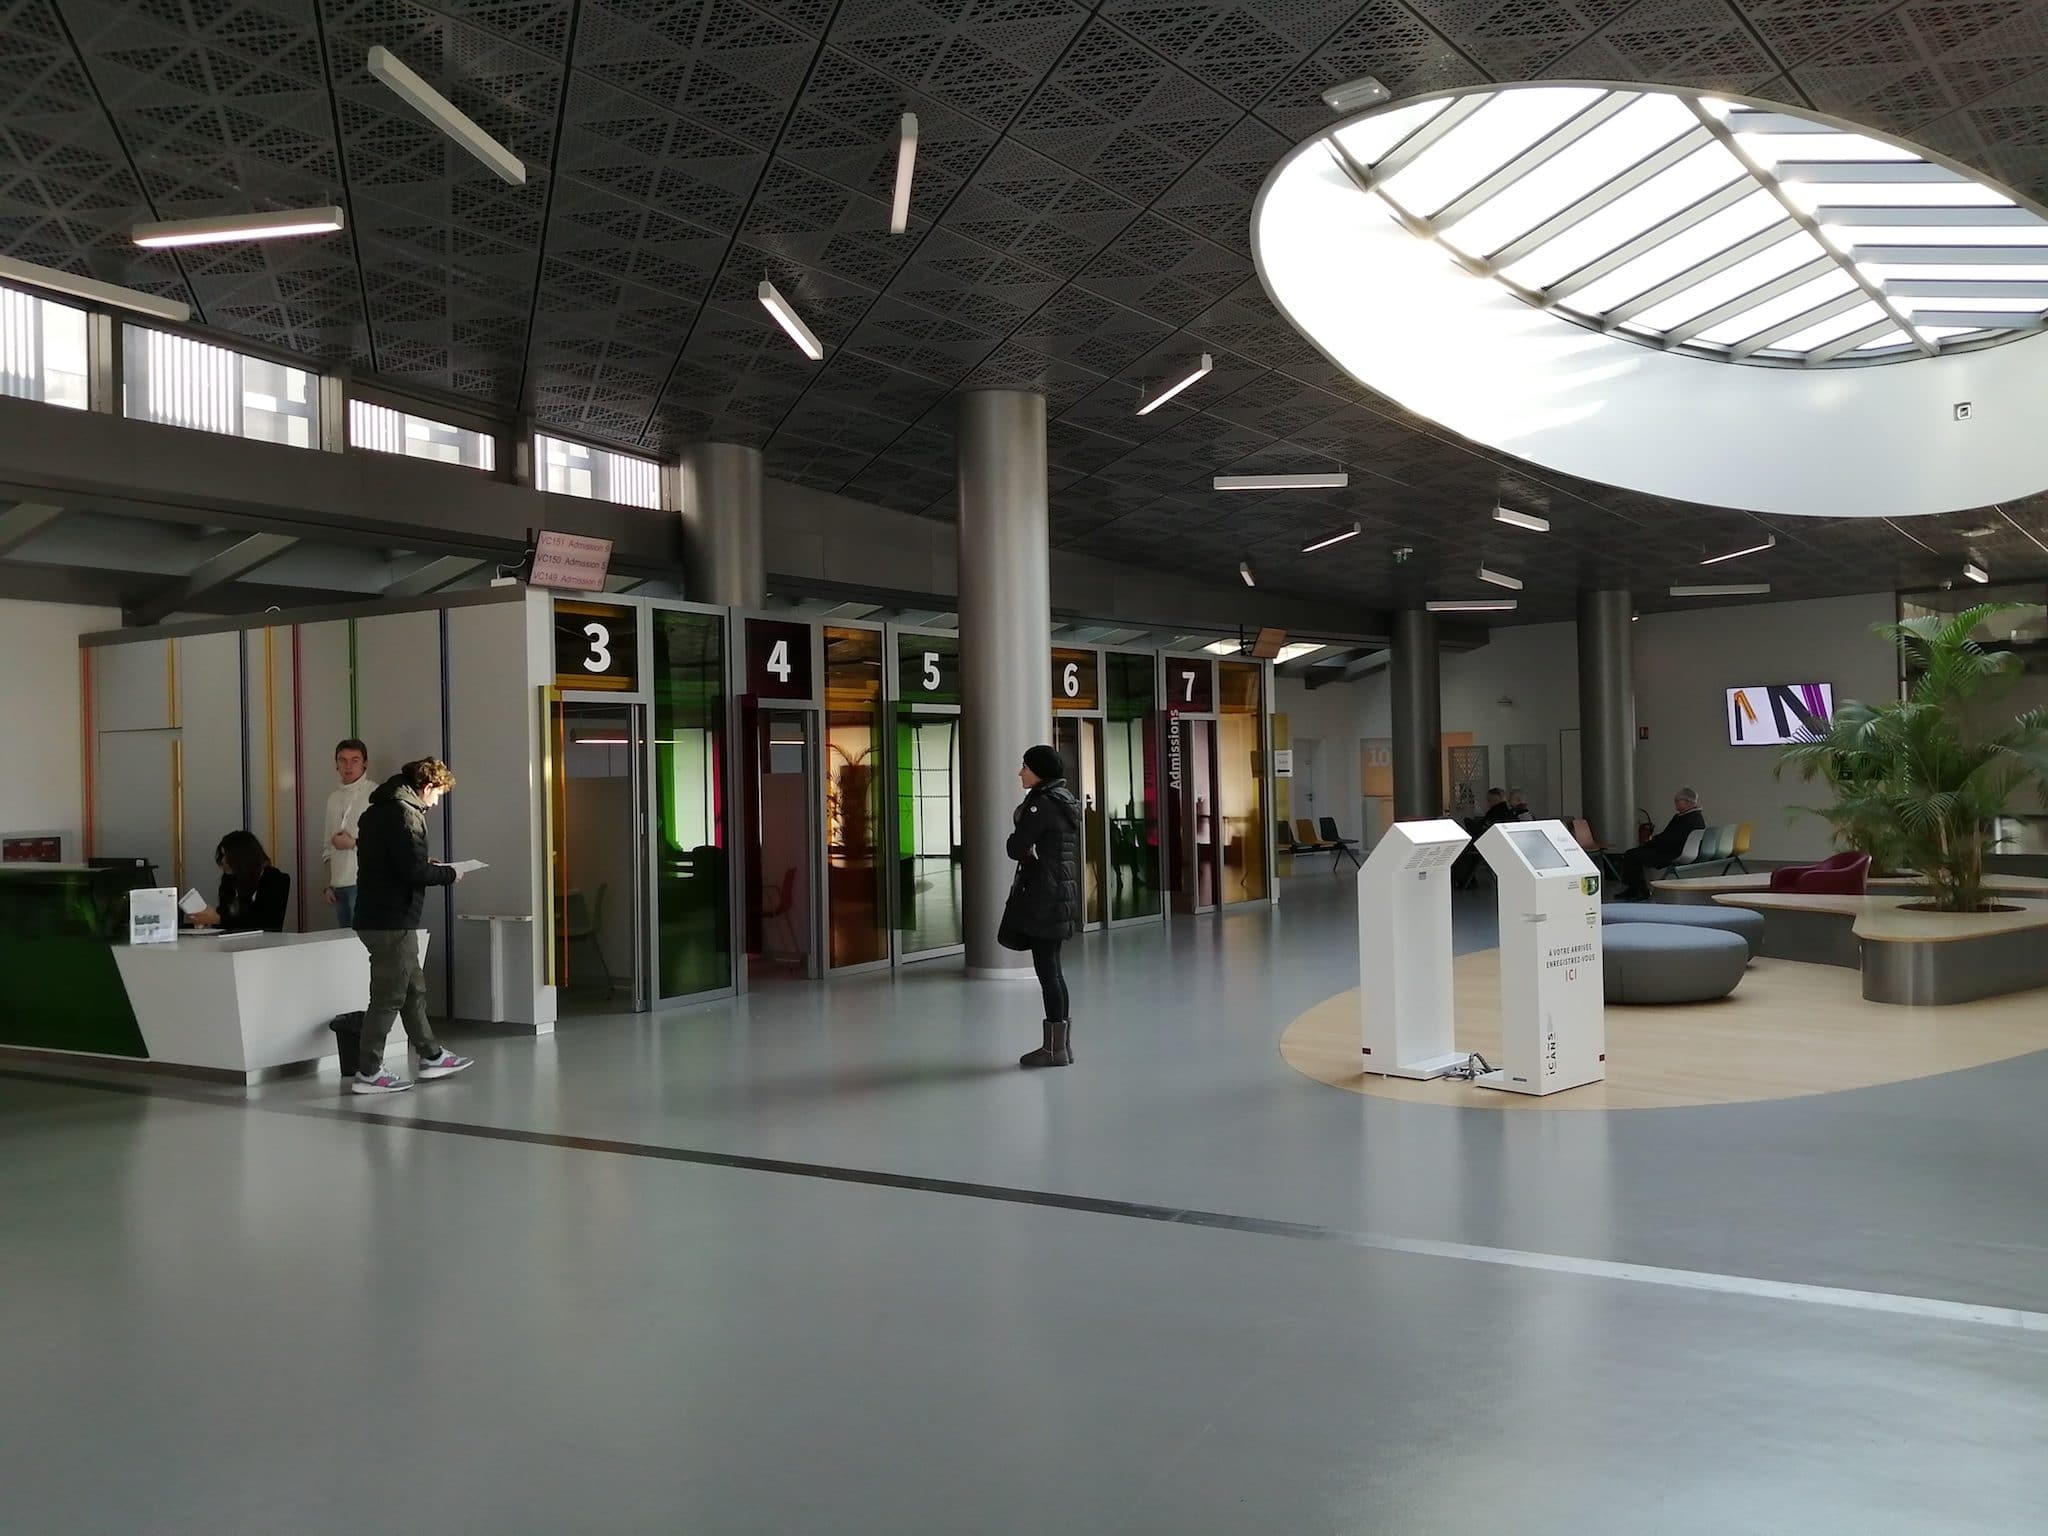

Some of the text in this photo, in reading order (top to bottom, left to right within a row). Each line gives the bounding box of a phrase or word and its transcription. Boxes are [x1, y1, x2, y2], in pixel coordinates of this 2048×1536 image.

[564, 557, 600, 569] Admission
[582, 622, 612, 673] 3
[766, 640, 792, 683] 4
[922, 652, 941, 691] 5
[1063, 662, 1080, 698] 6
[1182, 671, 1196, 702] 7
[1168, 708, 1181, 790] Admissions
[1565, 968, 1577, 982] ICI
